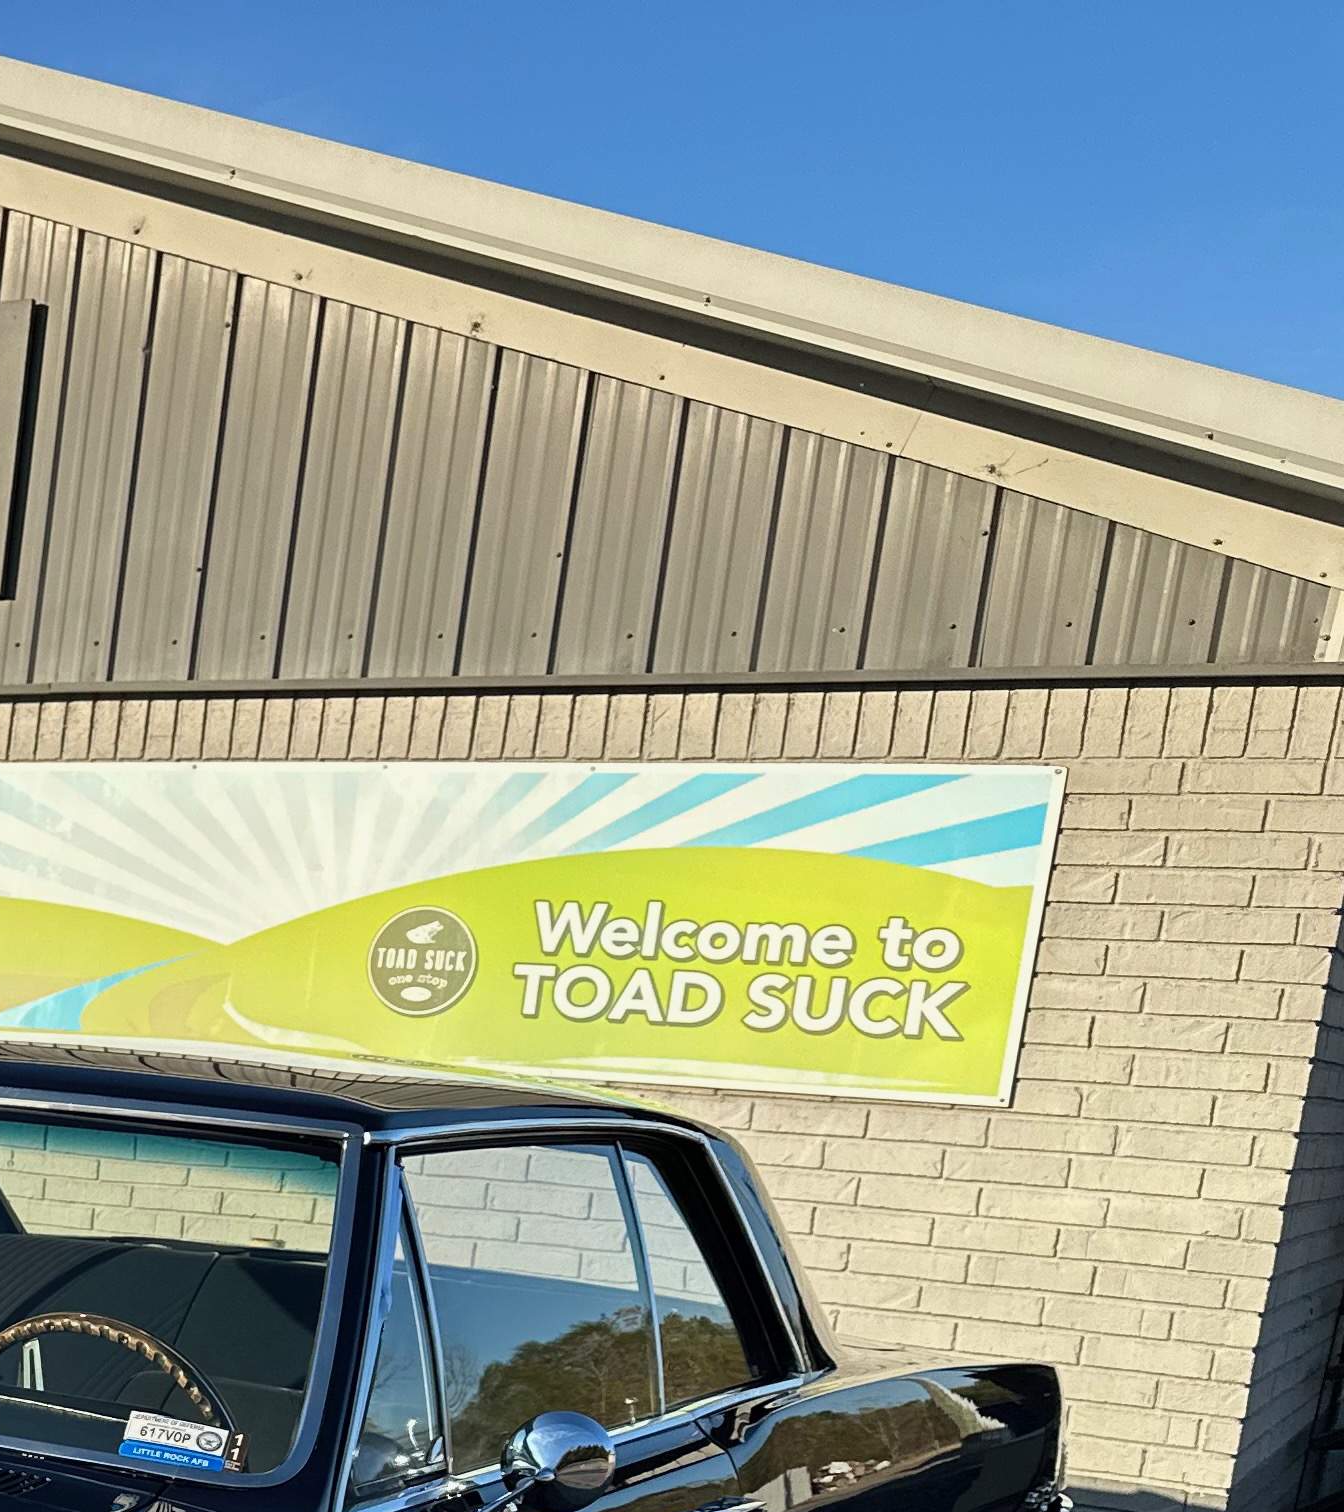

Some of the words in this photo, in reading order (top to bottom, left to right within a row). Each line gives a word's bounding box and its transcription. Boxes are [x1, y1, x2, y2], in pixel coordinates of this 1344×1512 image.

[535, 900, 854, 966] Welcome
[879, 916, 965, 973] to
[377, 948, 418, 969] TOAD
[424, 950, 467, 972] SUCK
[388, 975, 413, 985] one
[417, 974, 448, 989] stop
[513, 964, 723, 1028] TOAD
[743, 973, 969, 1042] SUCK
[133, 1447, 161, 1458] LITTLE
[163, 1452, 190, 1463] ROCK
[191, 1458, 209, 1467] AFB
